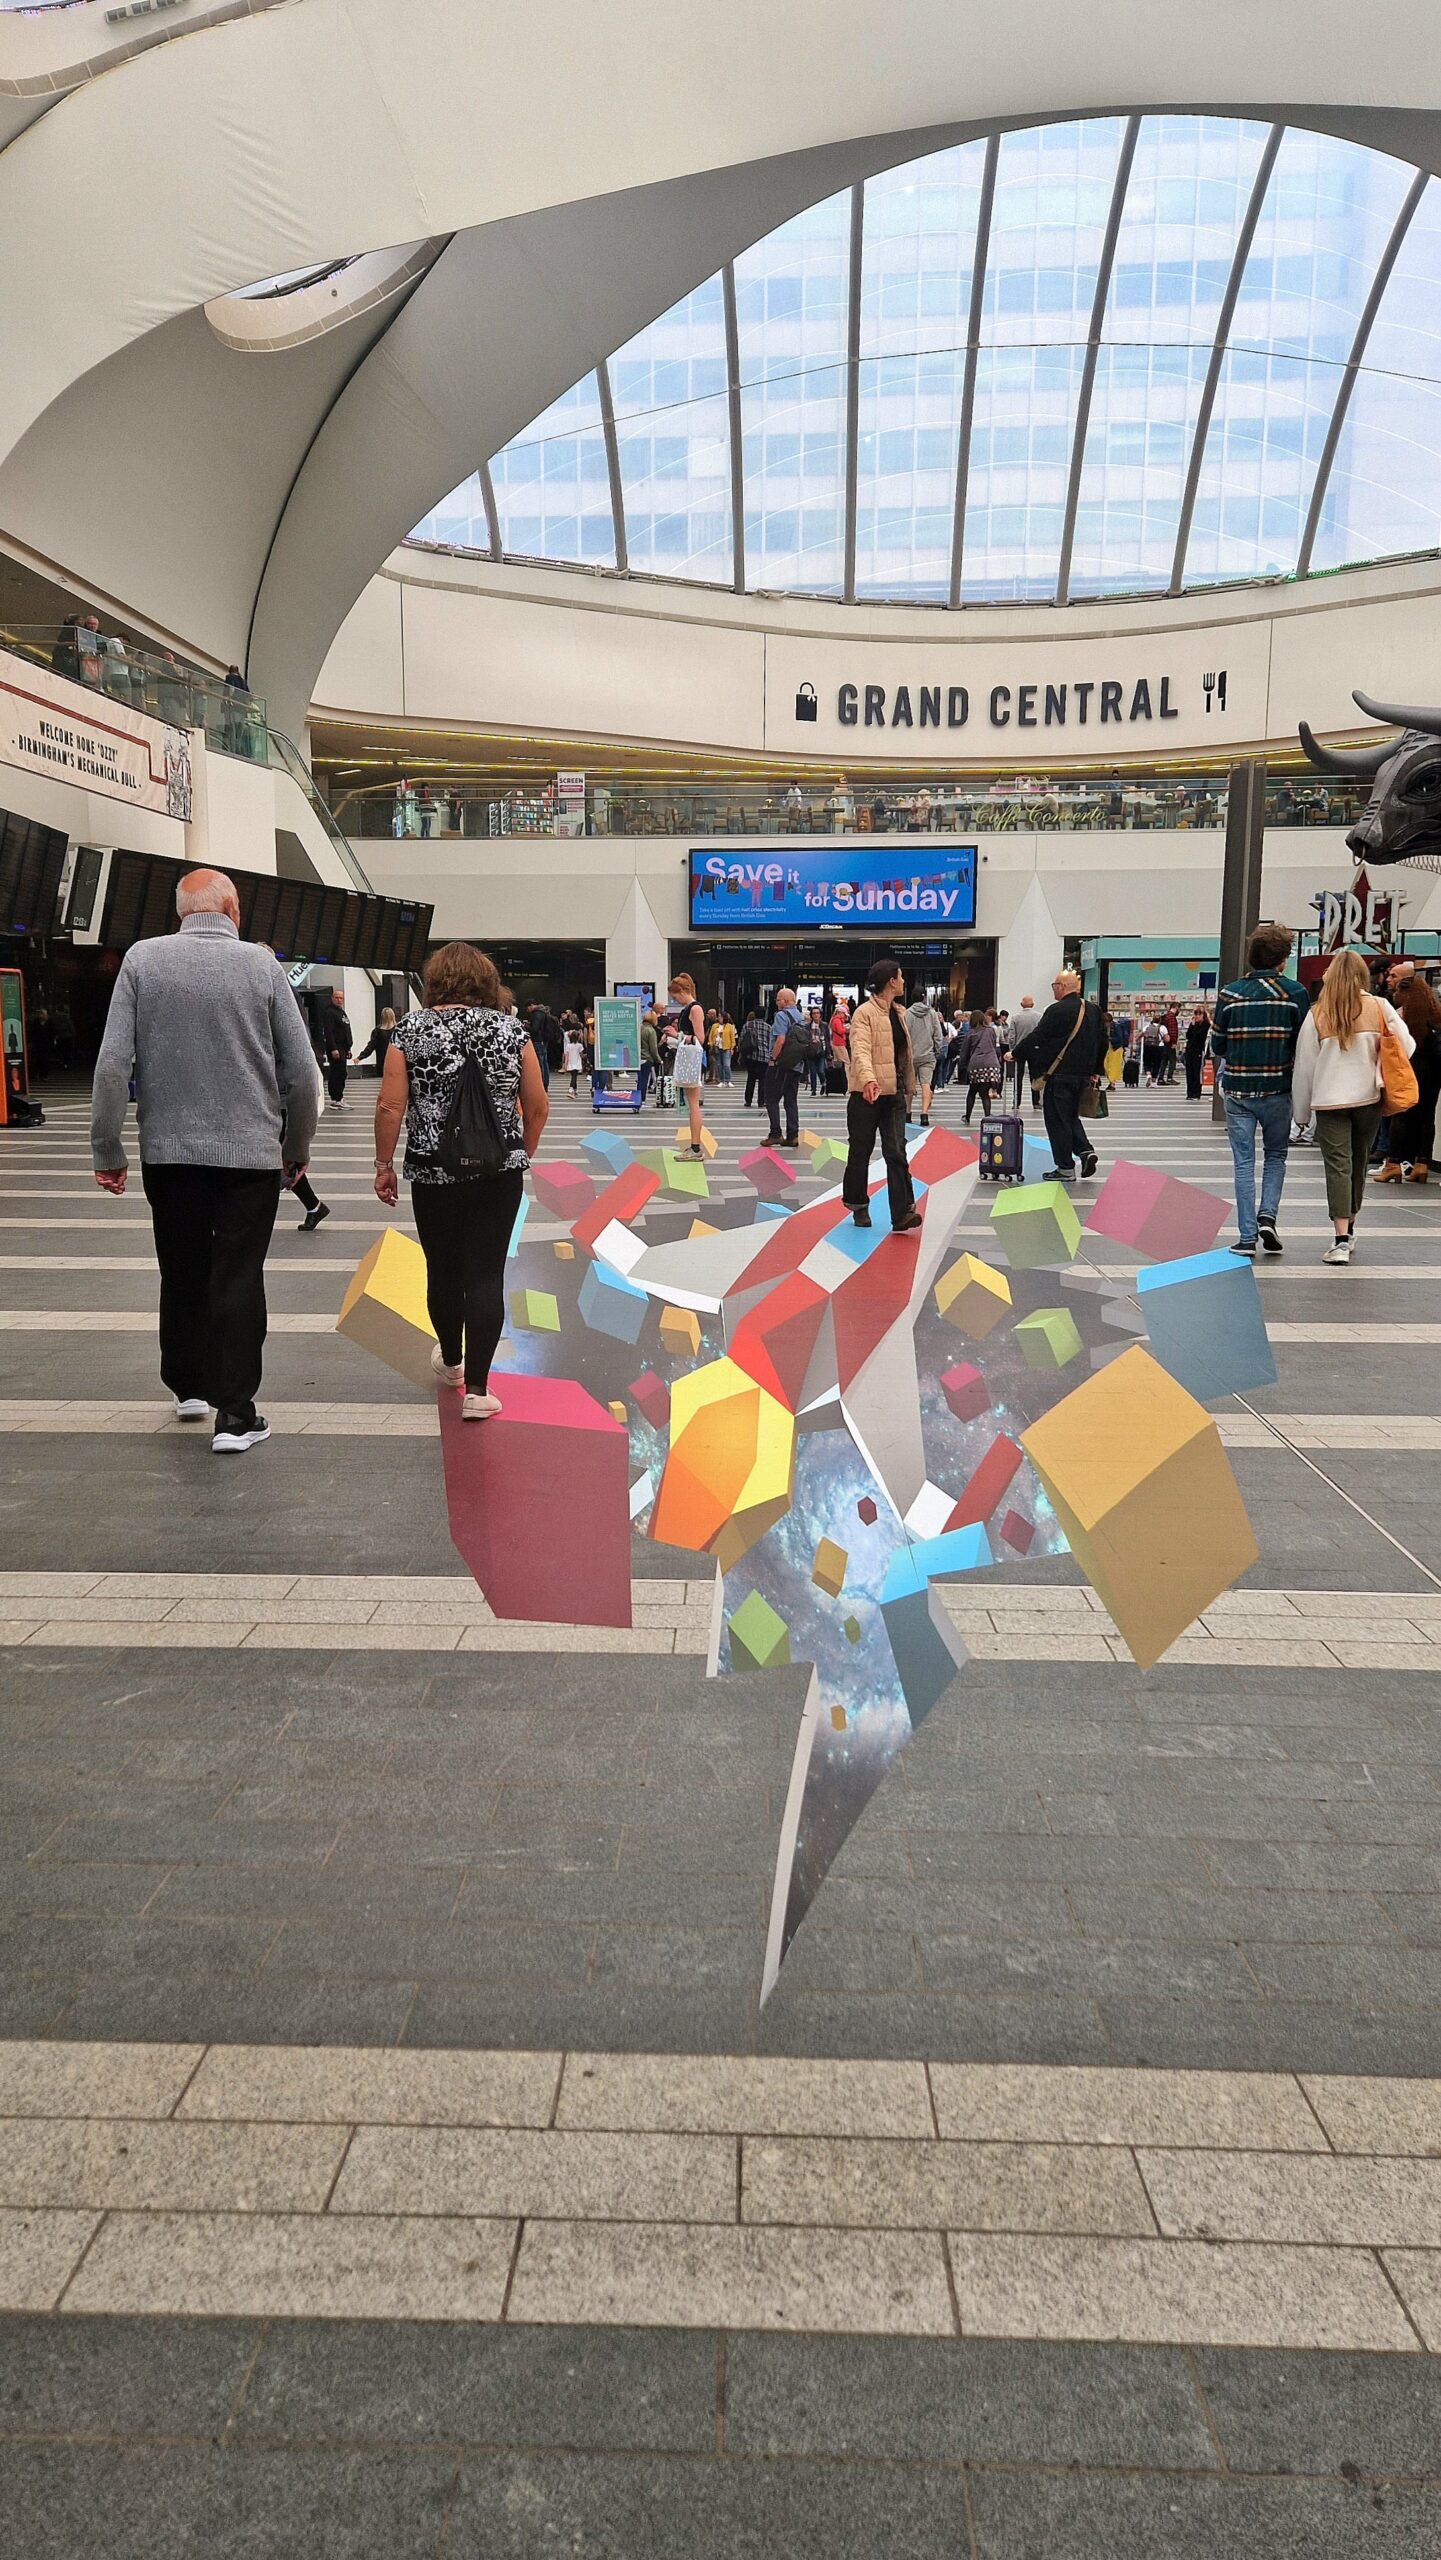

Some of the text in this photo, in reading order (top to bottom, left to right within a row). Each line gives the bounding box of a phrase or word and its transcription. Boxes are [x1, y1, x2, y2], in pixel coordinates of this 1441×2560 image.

[838, 676, 1179, 727] GRAND CENTRAL
[39, 720, 73, 747] WELCOME
[76, 734, 95, 755] HOME
[19, 734, 137, 789] BIRMINGHAM'S MECHANICAL BULL
[1025, 800, 1107, 823] Concerto
[705, 857, 800, 885] Save it
[804, 882, 960, 916] for Sunday
[1323, 889, 1407, 944] PRET
